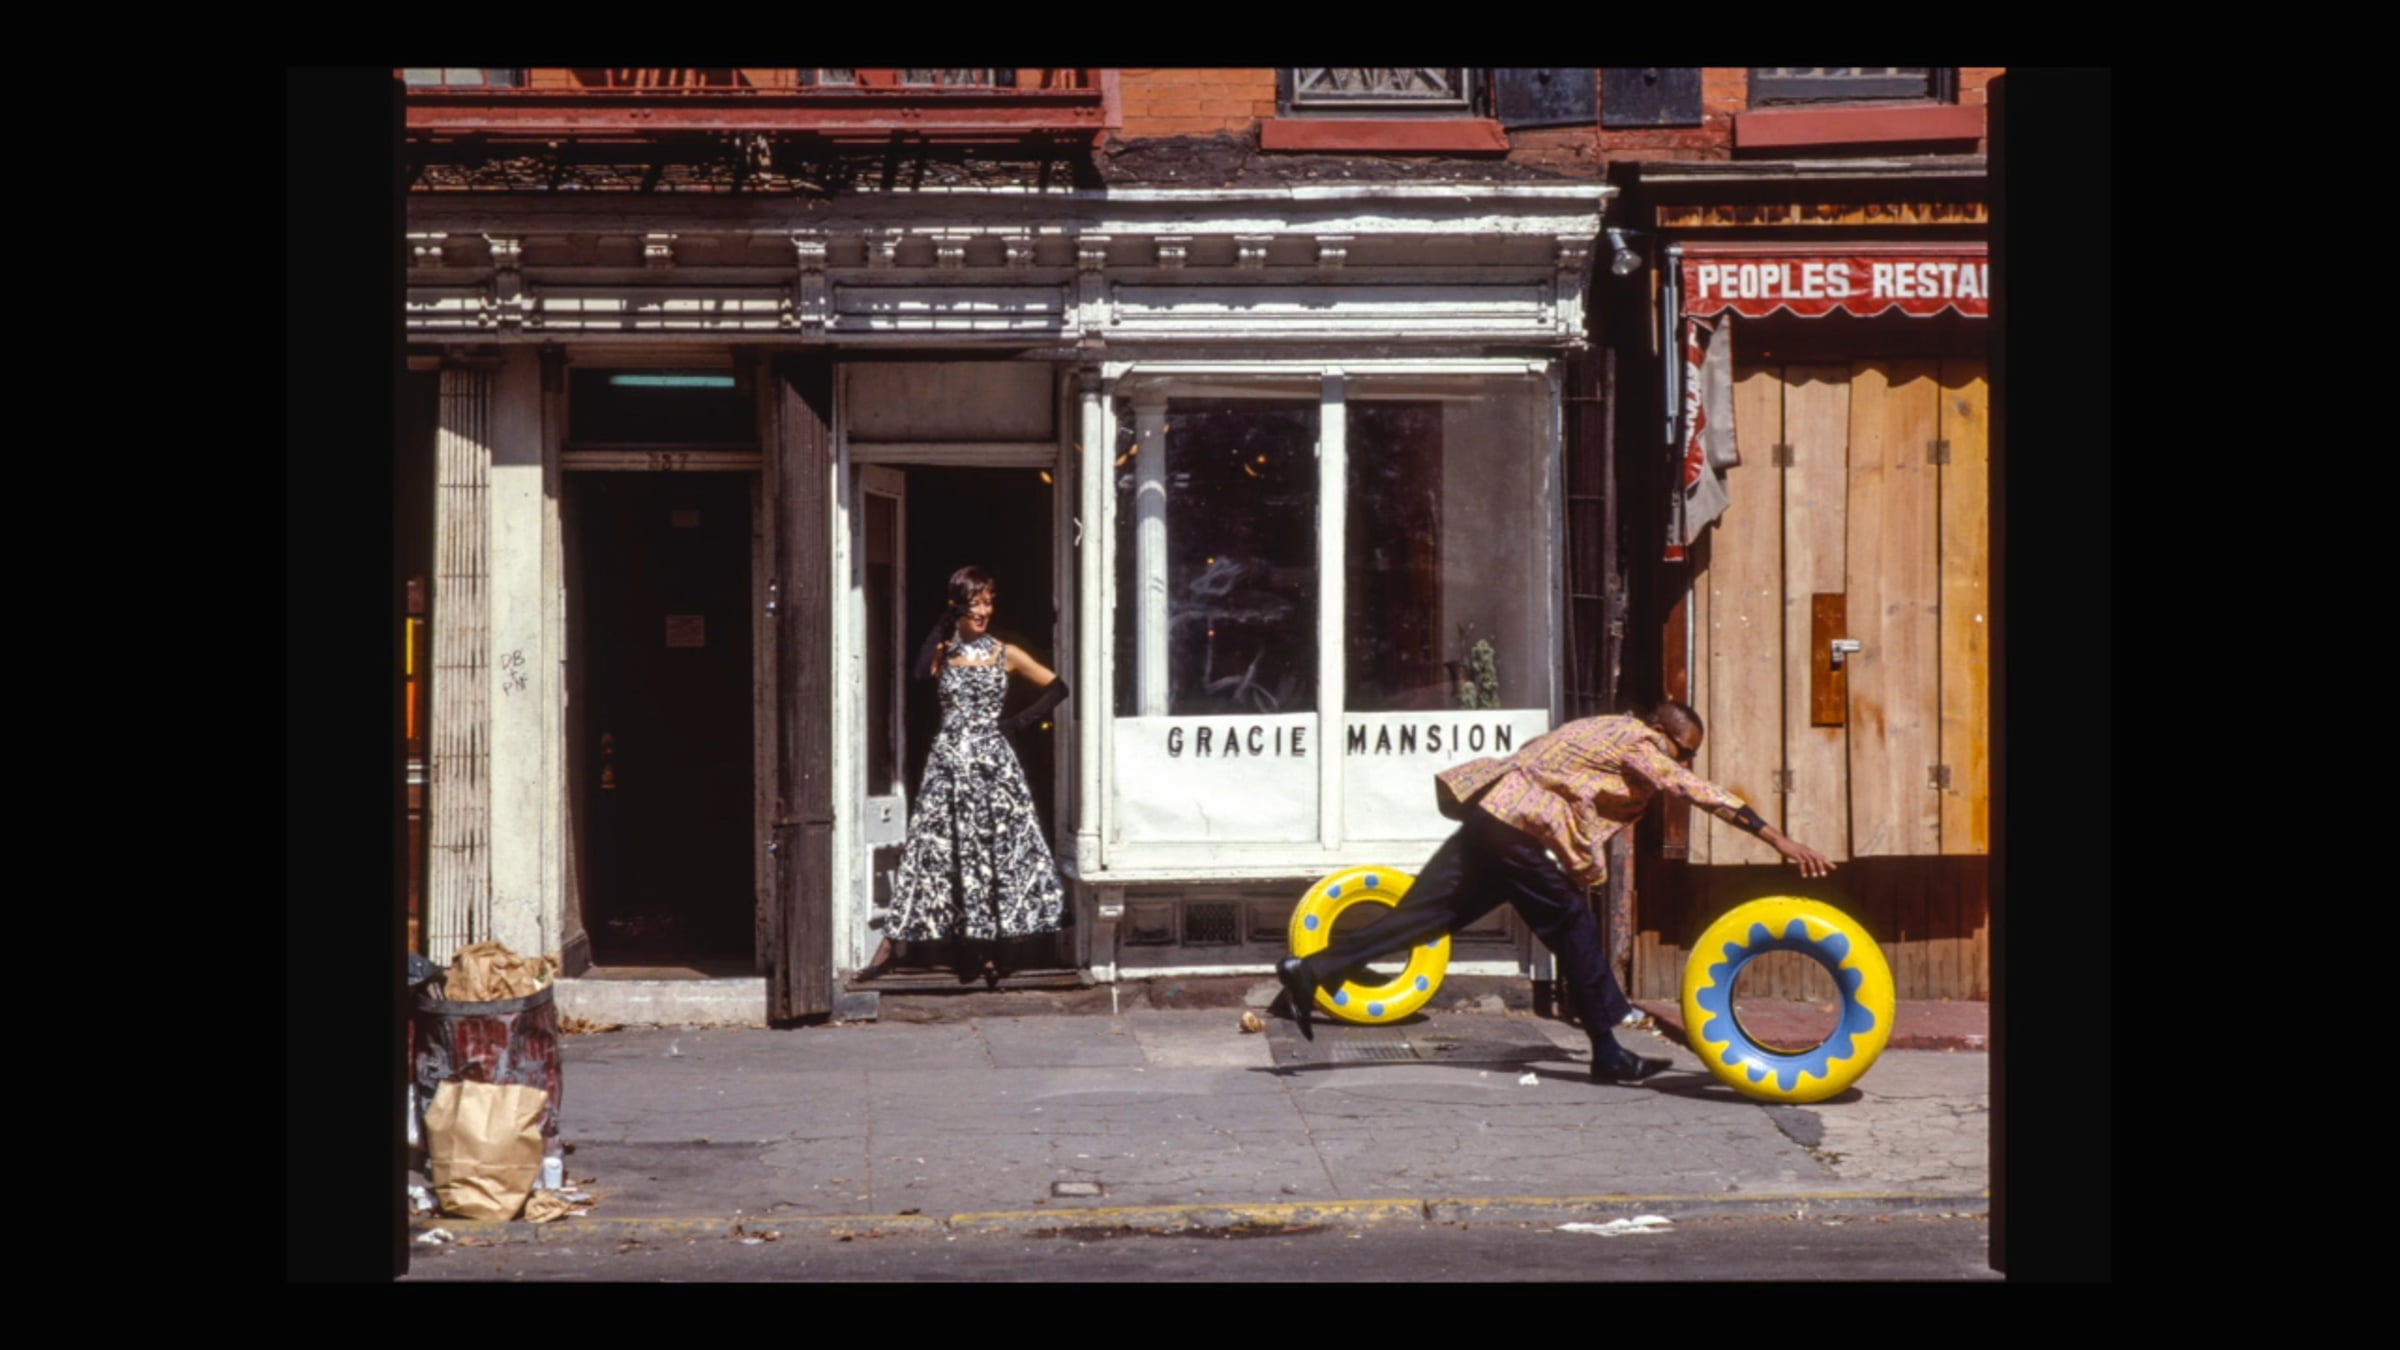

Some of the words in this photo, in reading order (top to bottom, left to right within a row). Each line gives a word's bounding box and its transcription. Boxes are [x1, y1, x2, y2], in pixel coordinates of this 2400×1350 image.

[1698, 263, 1850, 299] PEOPLES
[1168, 726, 1307, 757] GRACIE
[1347, 724, 1513, 755] MANSION
